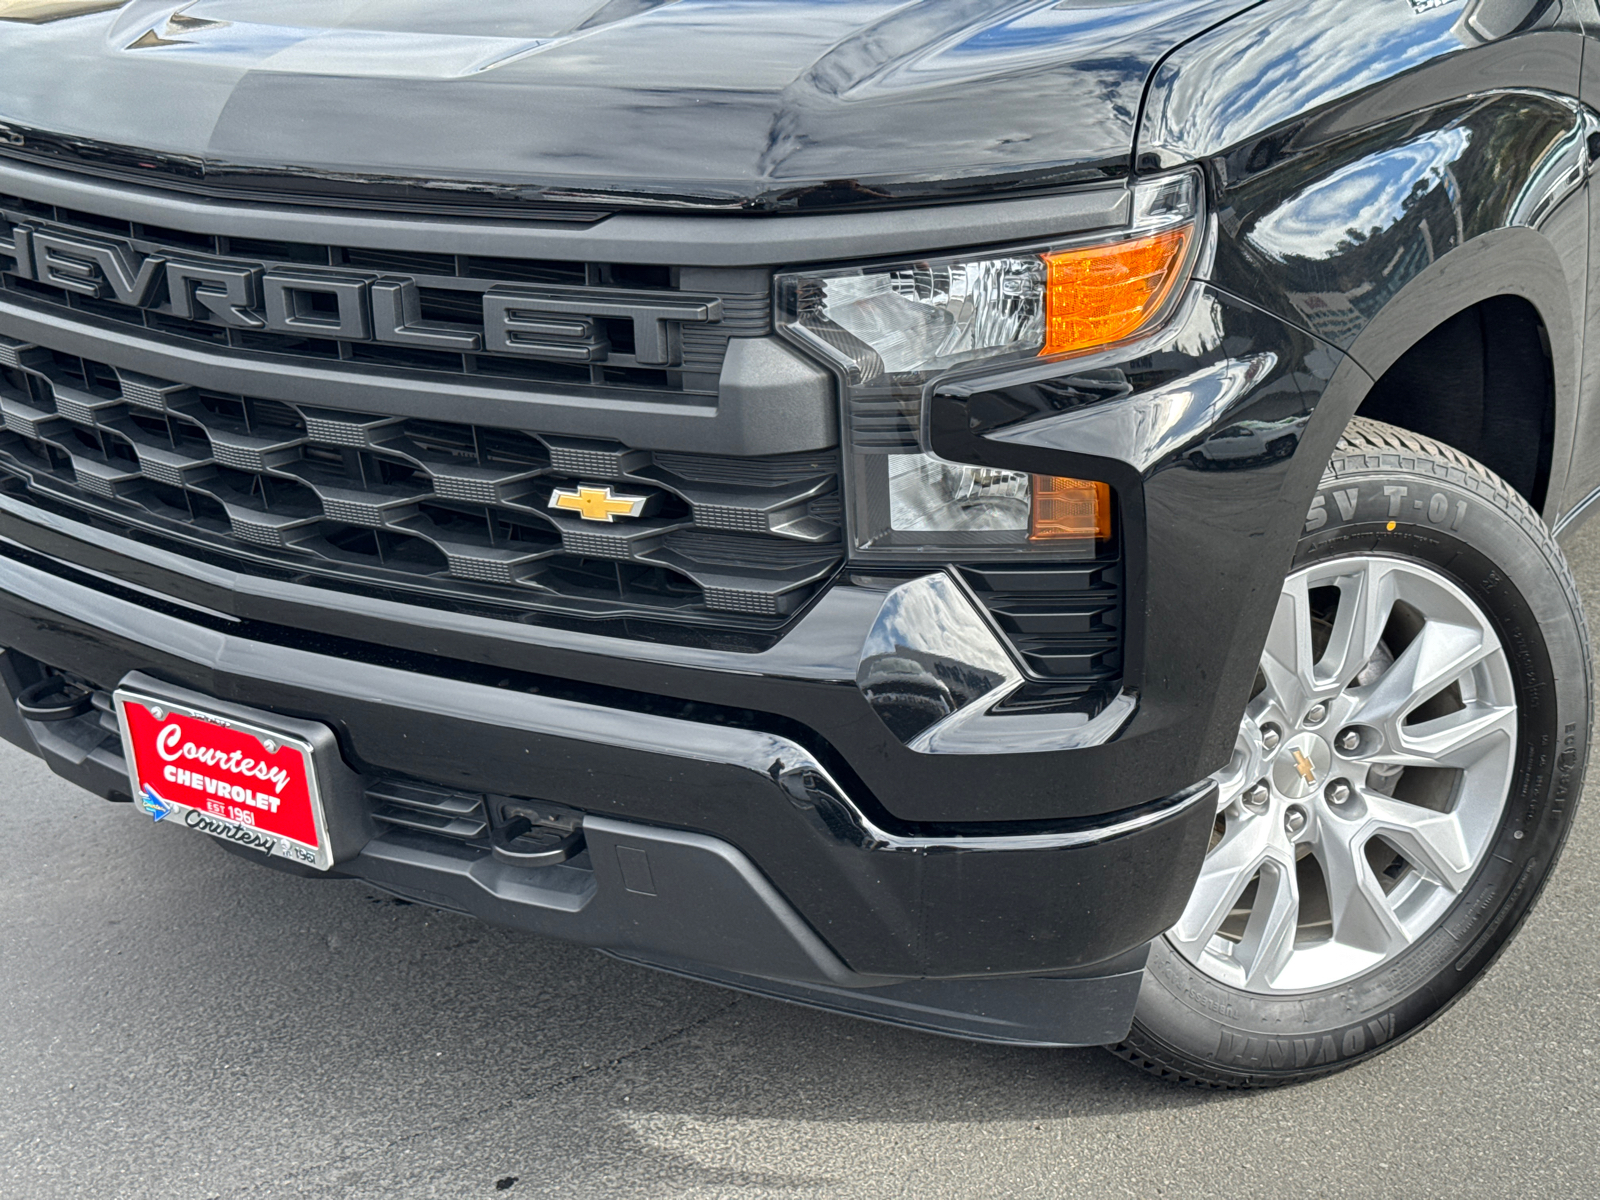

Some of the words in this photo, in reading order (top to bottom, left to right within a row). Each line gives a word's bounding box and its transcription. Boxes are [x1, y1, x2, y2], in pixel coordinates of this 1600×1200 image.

[156, 723, 290, 794] Courtesy
[163, 765, 281, 813] CHEVROLET
[206, 801, 226, 814] EST
[228, 805, 255, 826] 1961
[184, 808, 278, 857] Courtesy
[1214, 1012, 1396, 1069] ADVANTA
